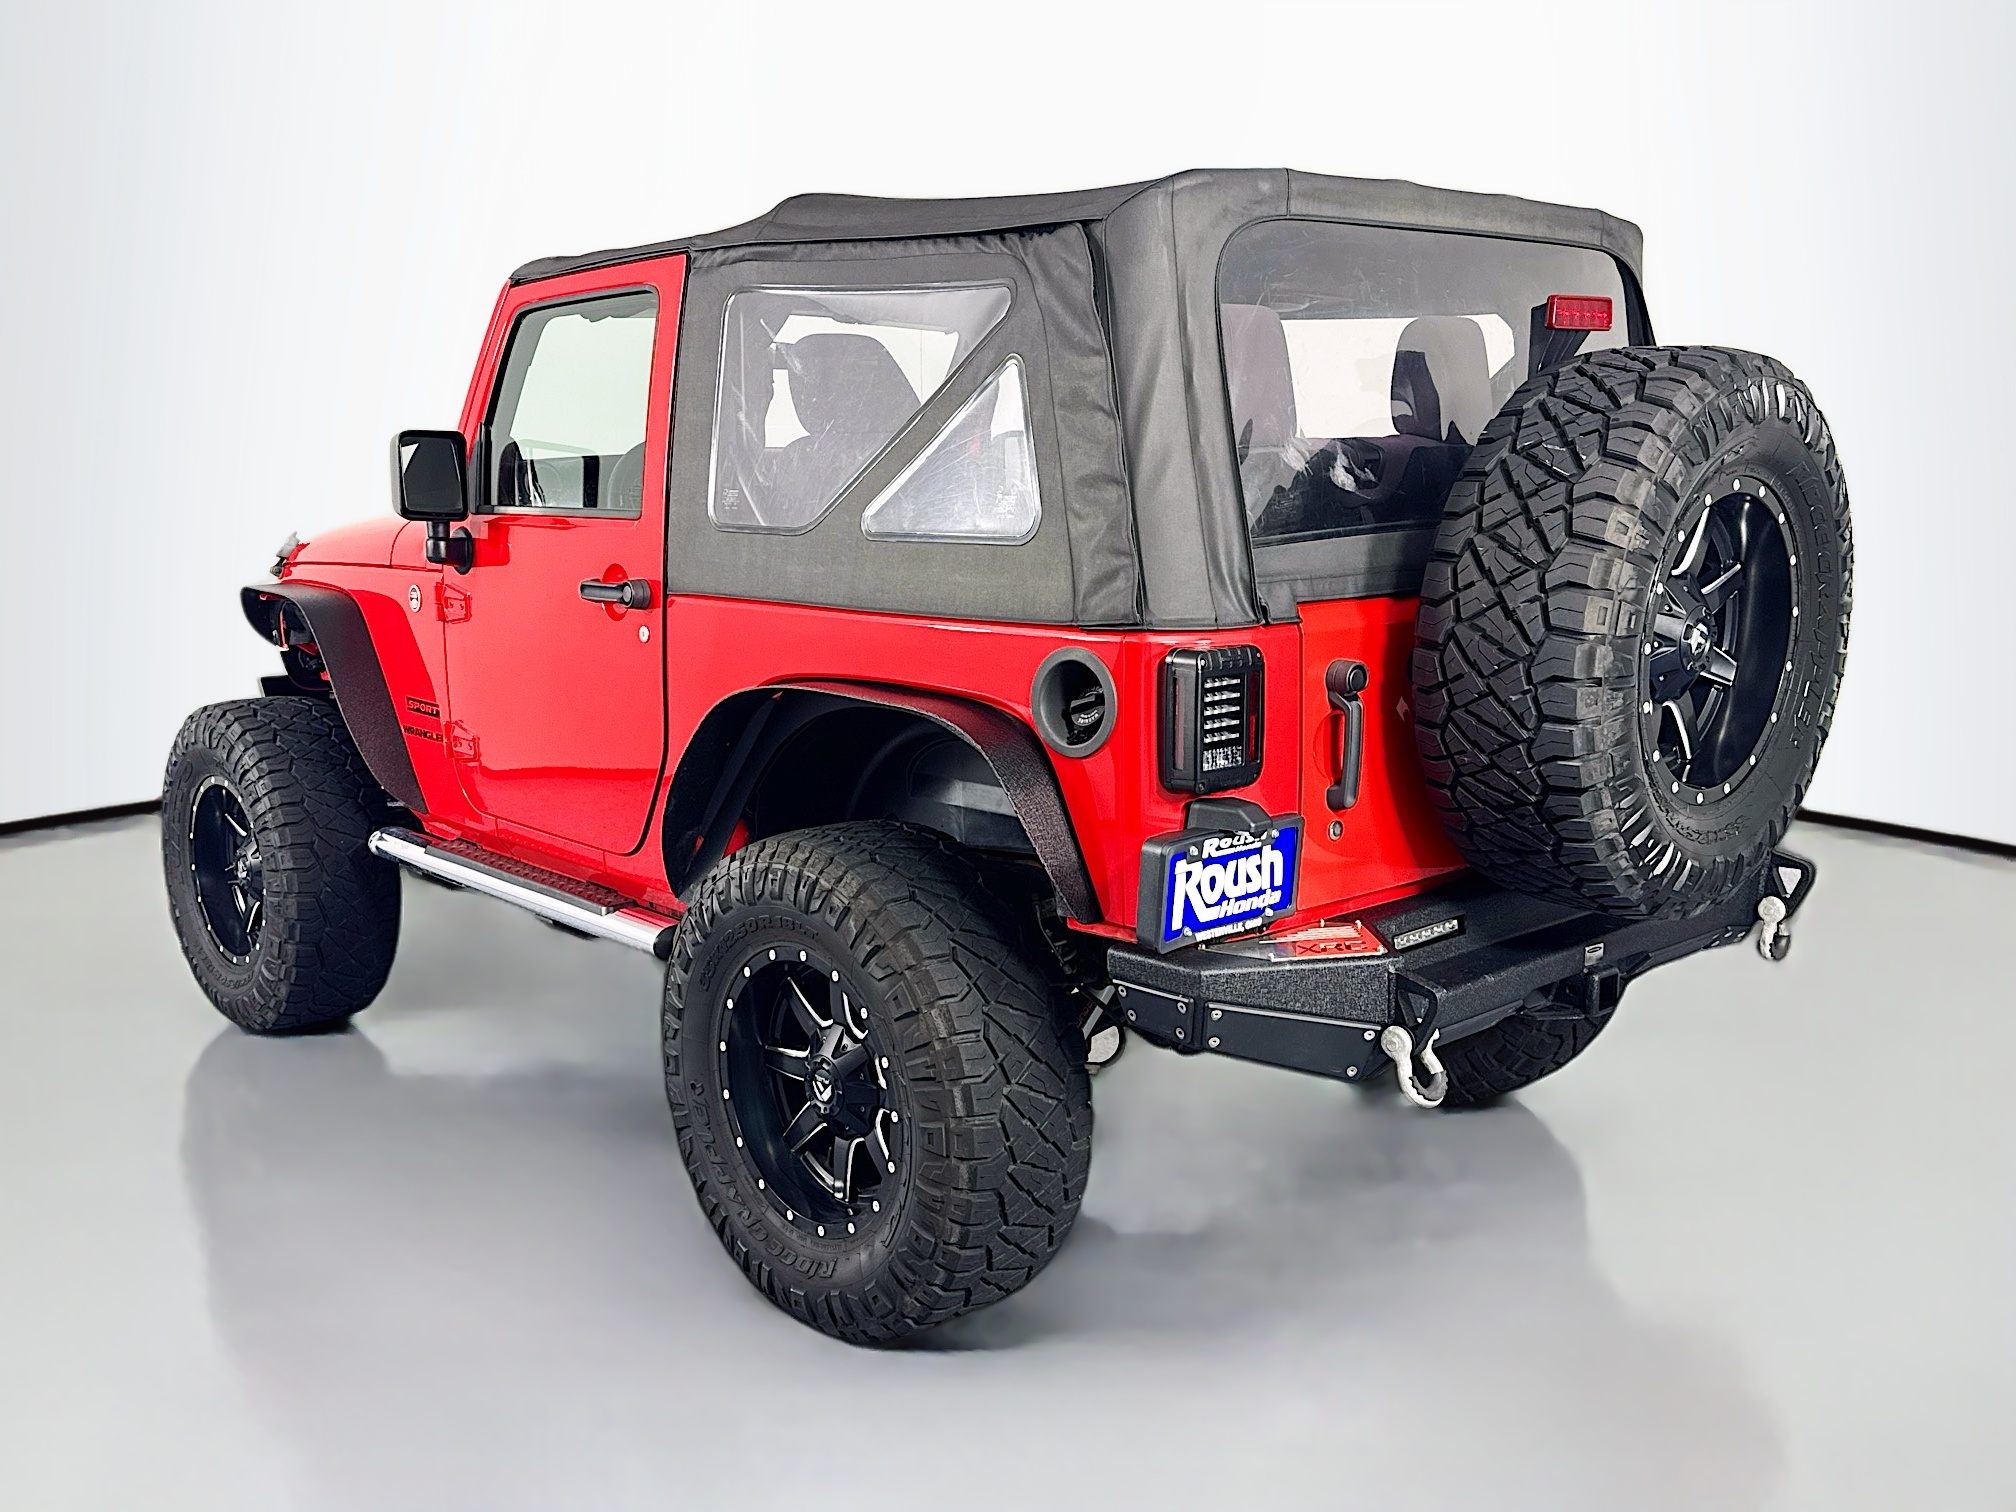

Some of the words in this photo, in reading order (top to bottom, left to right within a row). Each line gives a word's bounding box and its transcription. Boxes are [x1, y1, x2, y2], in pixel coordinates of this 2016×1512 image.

[408, 700, 440, 714] SPORT
[1202, 831, 1267, 859] Rous
[1171, 844, 1284, 931] Roush
[1218, 888, 1282, 918] Honda
[690, 1080, 769, 1242] GRAPPLER
[765, 1238, 838, 1279] RIDGE
